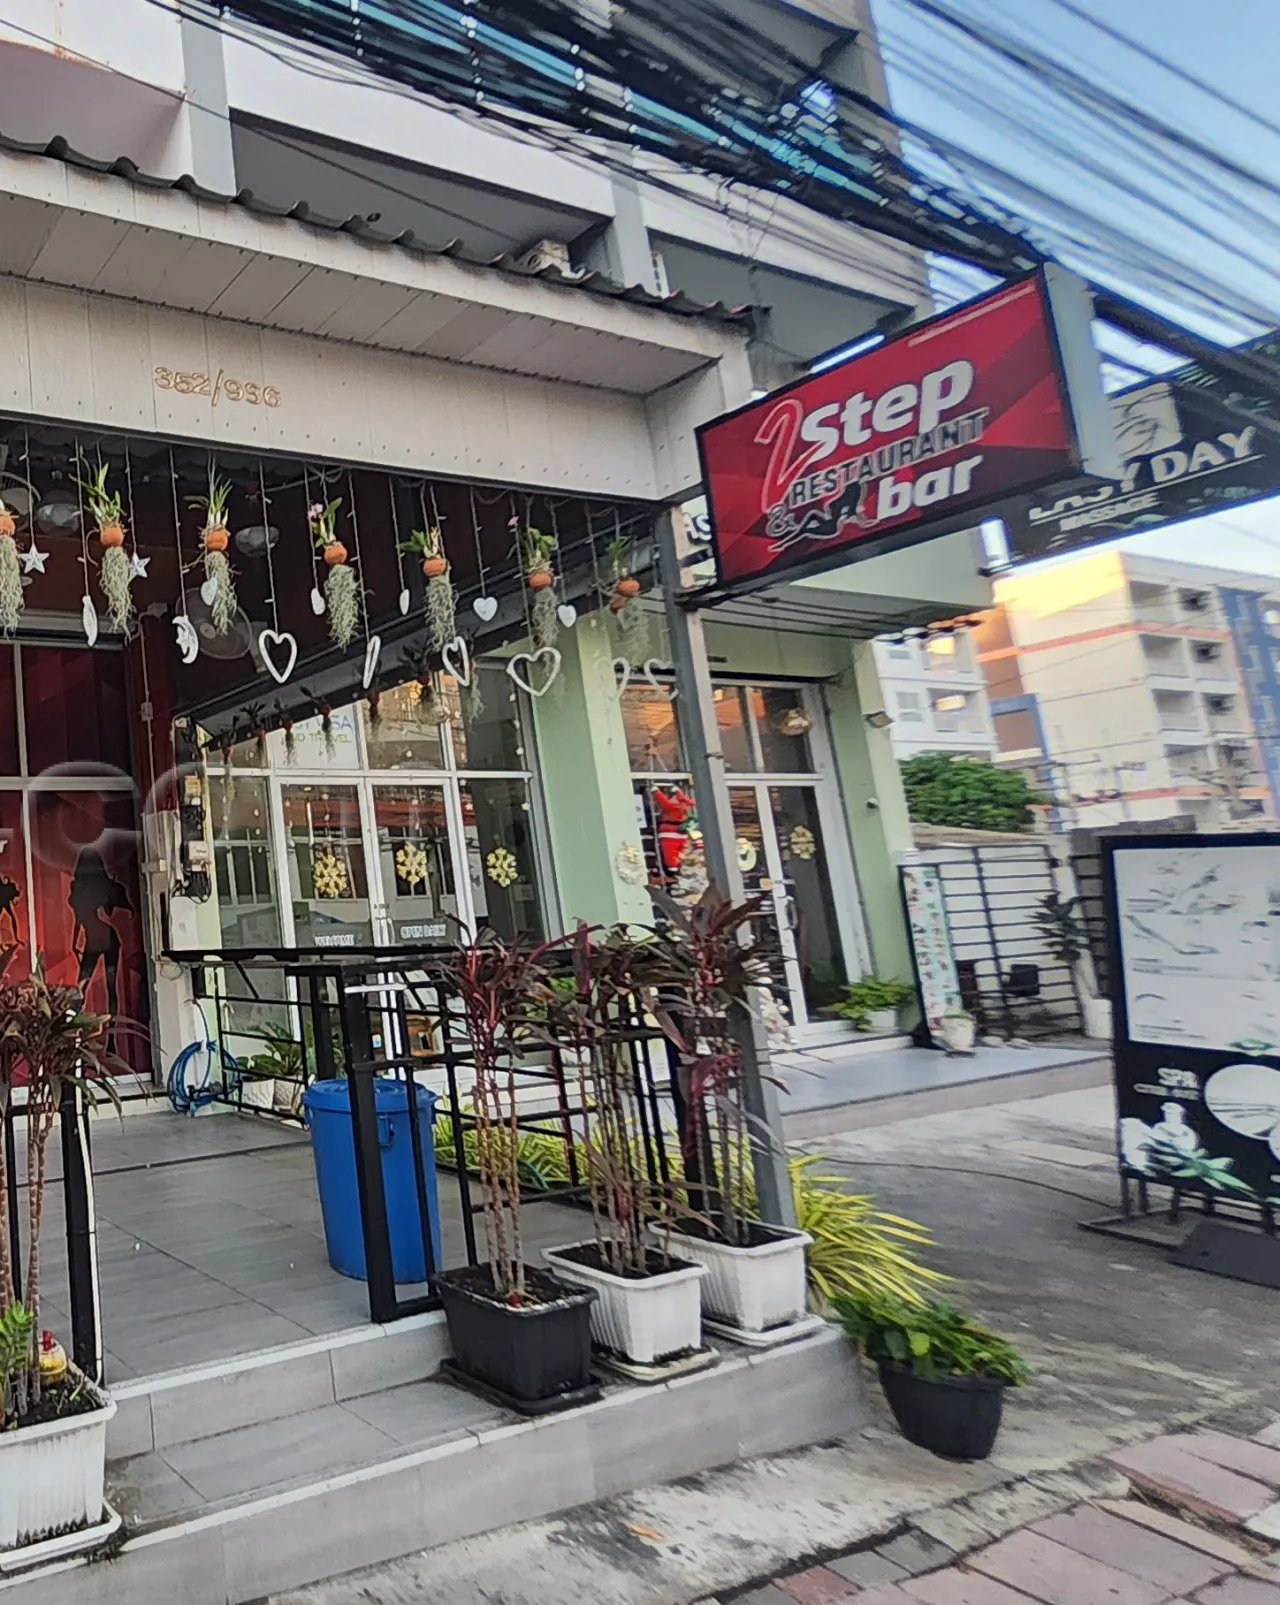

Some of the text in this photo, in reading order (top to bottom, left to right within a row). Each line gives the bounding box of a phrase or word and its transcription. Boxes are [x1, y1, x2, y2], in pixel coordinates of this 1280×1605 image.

[788, 406, 990, 510] RESTAURANT
[1150, 425, 1257, 484] DAY
[876, 455, 985, 521] bar
